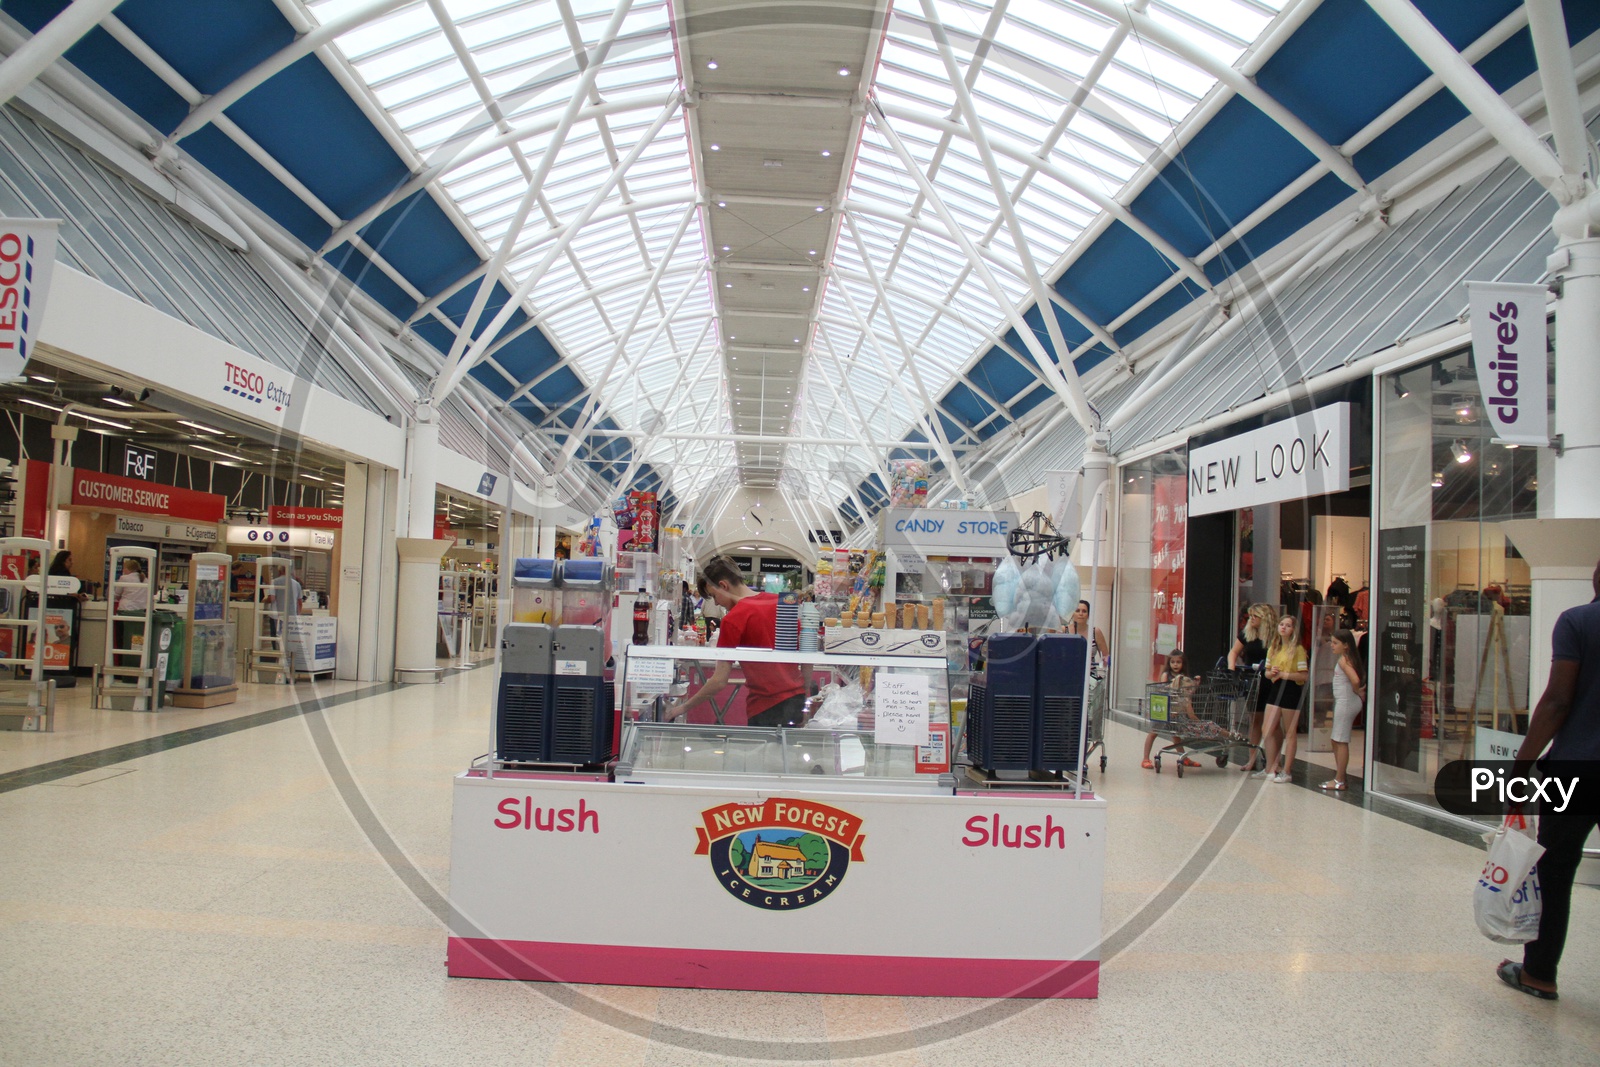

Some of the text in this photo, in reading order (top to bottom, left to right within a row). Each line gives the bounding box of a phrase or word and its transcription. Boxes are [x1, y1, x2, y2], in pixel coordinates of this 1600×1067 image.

[1489, 301, 1518, 424] claire's
[225, 361, 291, 407] TESCO extra
[125, 450, 155, 480] F&F
[1191, 429, 1331, 497] NEW LOOK
[78, 480, 170, 509] CUSTOMER SERVICE
[118, 518, 217, 540] Tobacco E-Cigarettes
[276, 510, 296, 519] Scan
[306, 514, 322, 522] you
[322, 513, 343, 523] Shop
[895, 519, 1009, 535] CANDY STORE
[817, 534, 840, 542] next
[1153, 543, 1185, 573] SALE SAL
[882, 681, 905, 689] Staff
[1490, 744, 1510, 758] NEW
[494, 796, 600, 834] Slush
[713, 803, 850, 837] New Forest
[961, 813, 1065, 849] Slush
[721, 869, 837, 906] ICE CREAM
